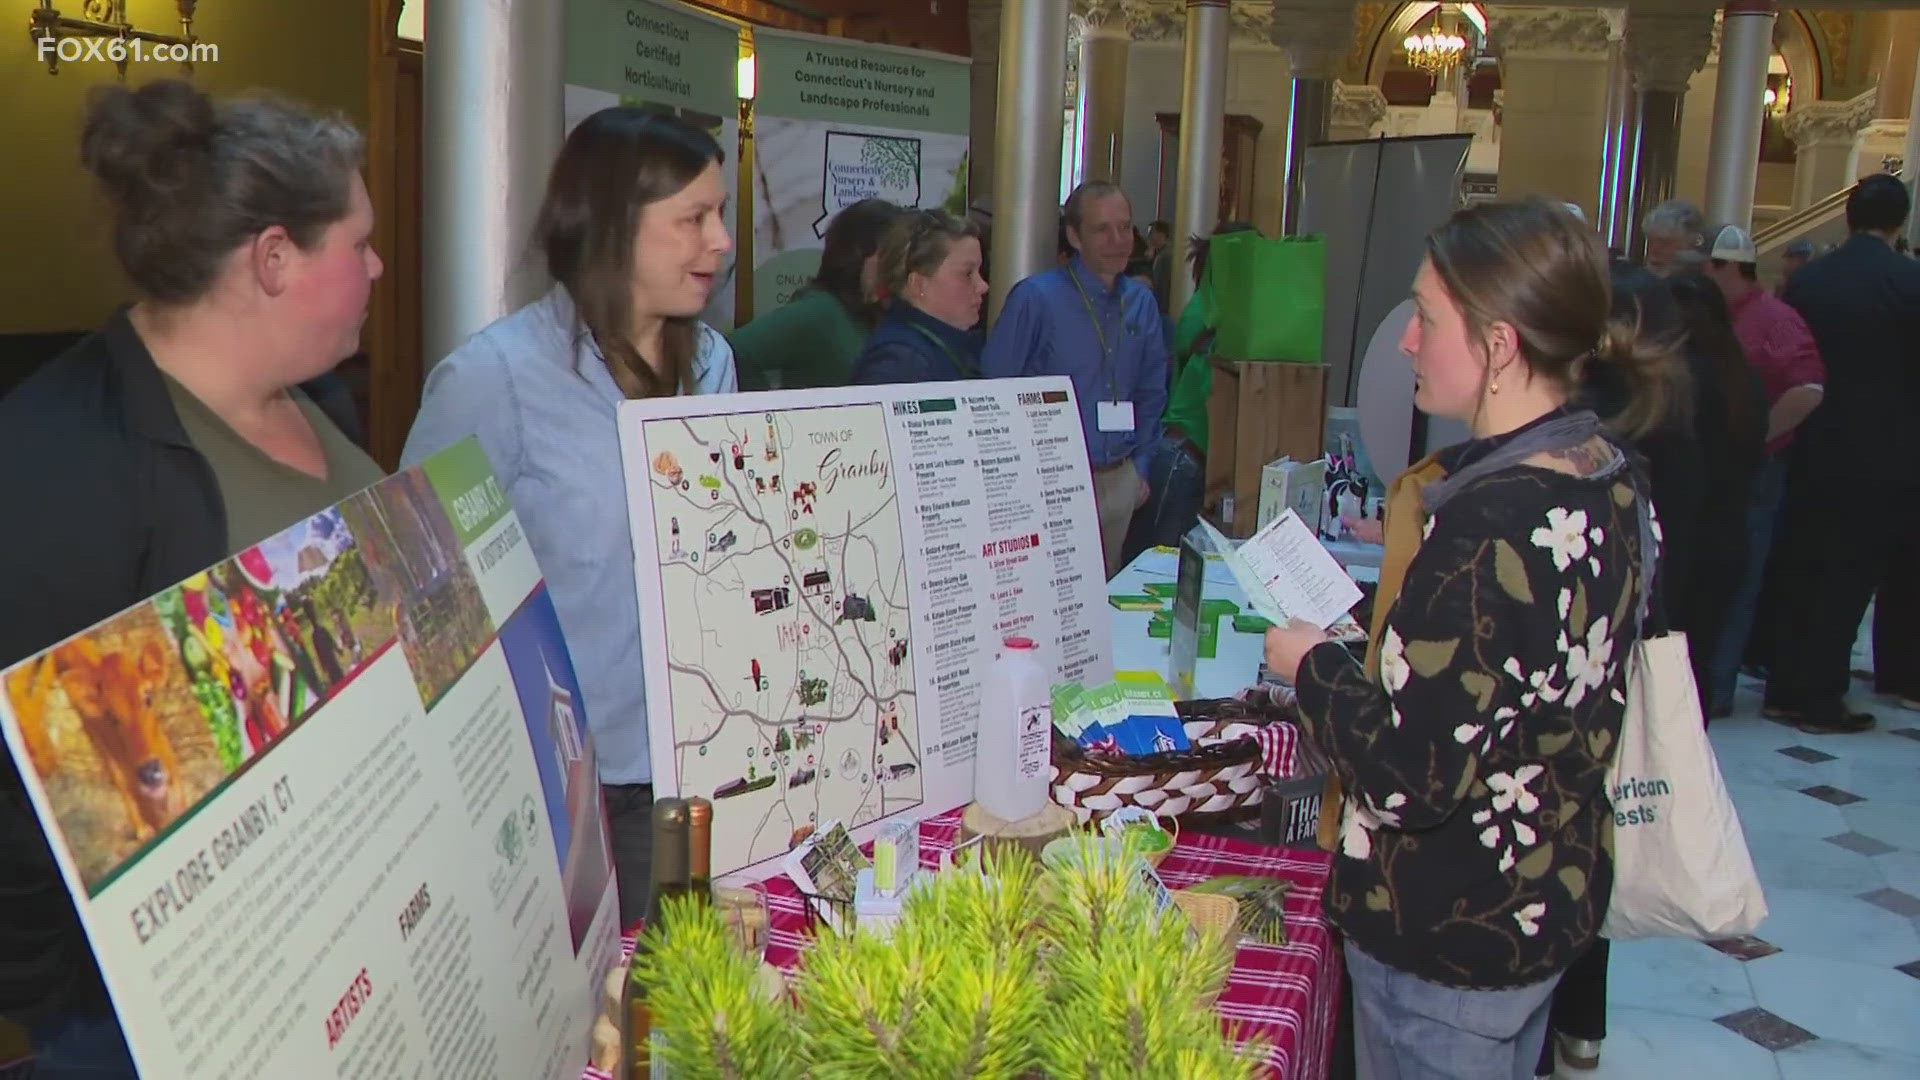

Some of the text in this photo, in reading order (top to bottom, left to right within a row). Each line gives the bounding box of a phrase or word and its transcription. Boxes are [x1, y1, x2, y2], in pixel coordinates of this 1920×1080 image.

[626, 9, 690, 41] Connecticut
[636, 40, 680, 67] Certified
[806, 51, 926, 78] A Trusted Resource for
[625, 65, 691, 96] Horticulturist
[795, 70, 935, 98] Connecticut's Nursery and
[800, 91, 930, 116] Landscape Professionals
[892, 401, 918, 416] HIKES
[1017, 391, 1042, 406] FARMS
[808, 429, 853, 445] TOWN OF
[817, 447, 889, 494] Granby
[982, 535, 1030, 558] ART STUDIOS
[1612, 777, 1670, 801] erican
[1290, 795, 1320, 826] THA
[1615, 805, 1655, 827] ests
[1286, 825, 1294, 844] A
[130, 774, 295, 945] EXPLORE GRANBY, CT
[399, 882, 431, 942] FARMS
[326, 967, 372, 1050] ARTISTS
